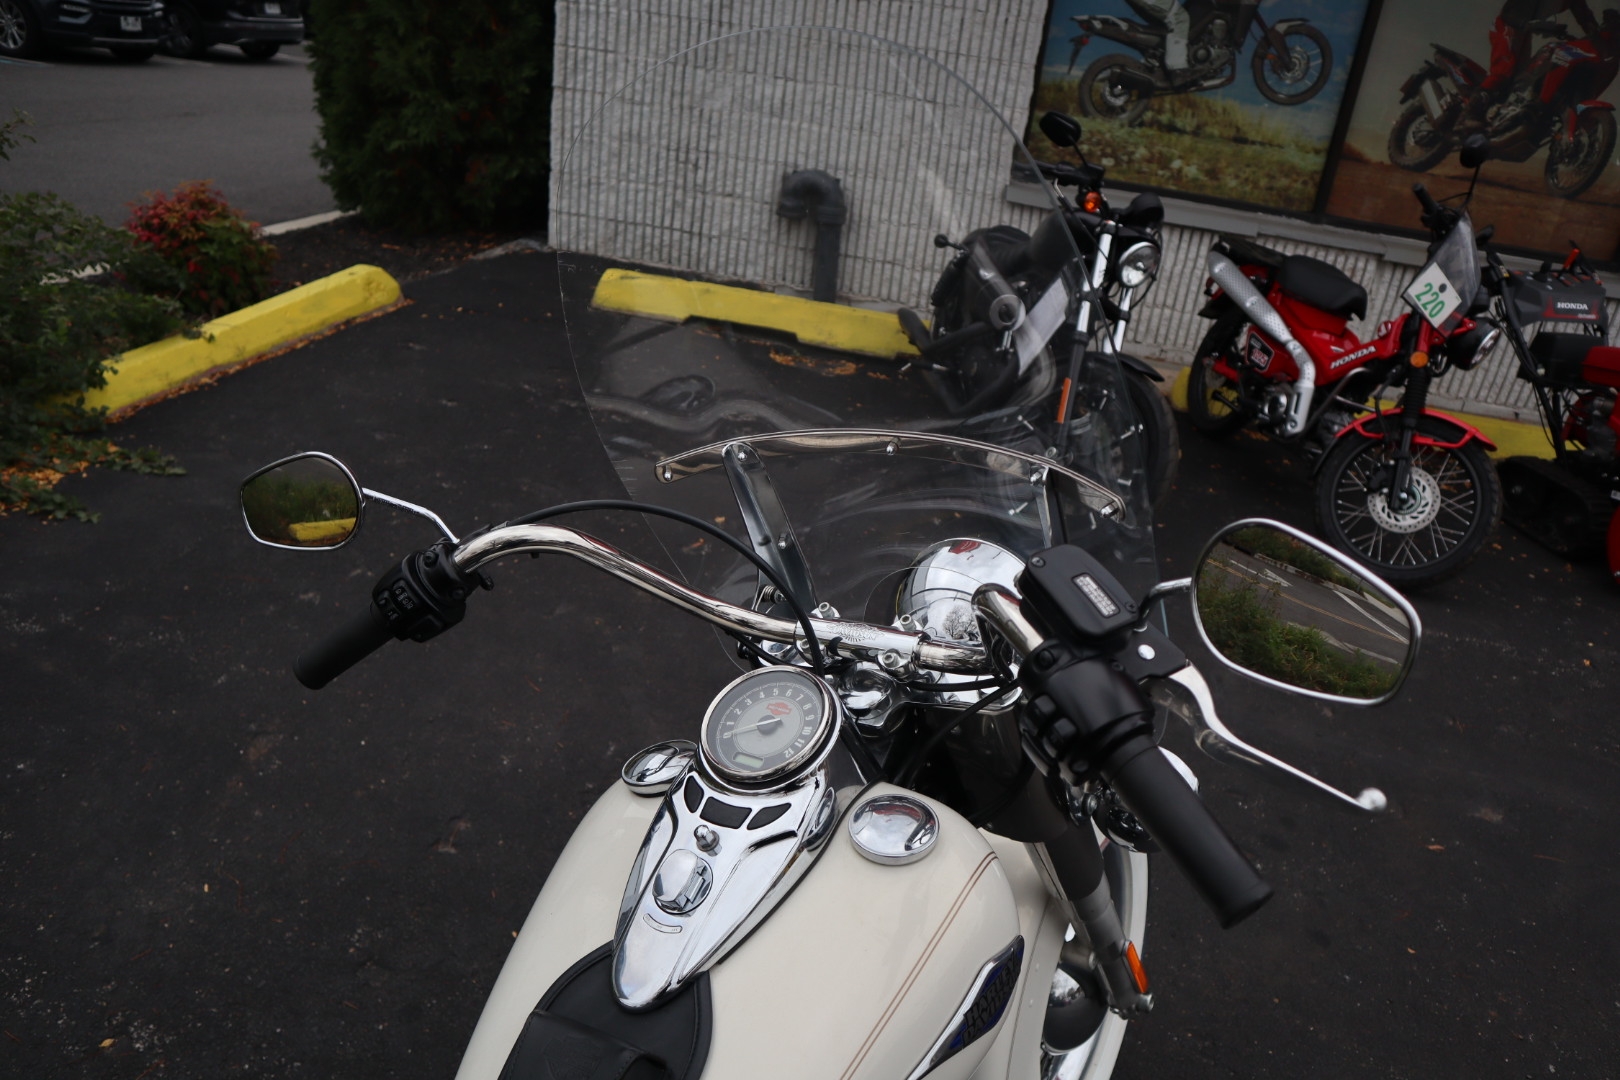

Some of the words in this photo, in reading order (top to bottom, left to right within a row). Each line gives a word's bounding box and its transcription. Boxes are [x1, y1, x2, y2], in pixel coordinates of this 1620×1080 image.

[1414, 282, 1446, 319] 220
[1557, 302, 1589, 311] HONDA
[1330, 345, 1377, 370] HONDA
[773, 688, 779, 696] 5
[785, 689, 792, 697] 6
[795, 693, 804, 701] 7
[744, 698, 752, 706] 3
[801, 726, 813, 735] 10
[794, 738, 805, 748] 11
[783, 748, 795, 758] 12
